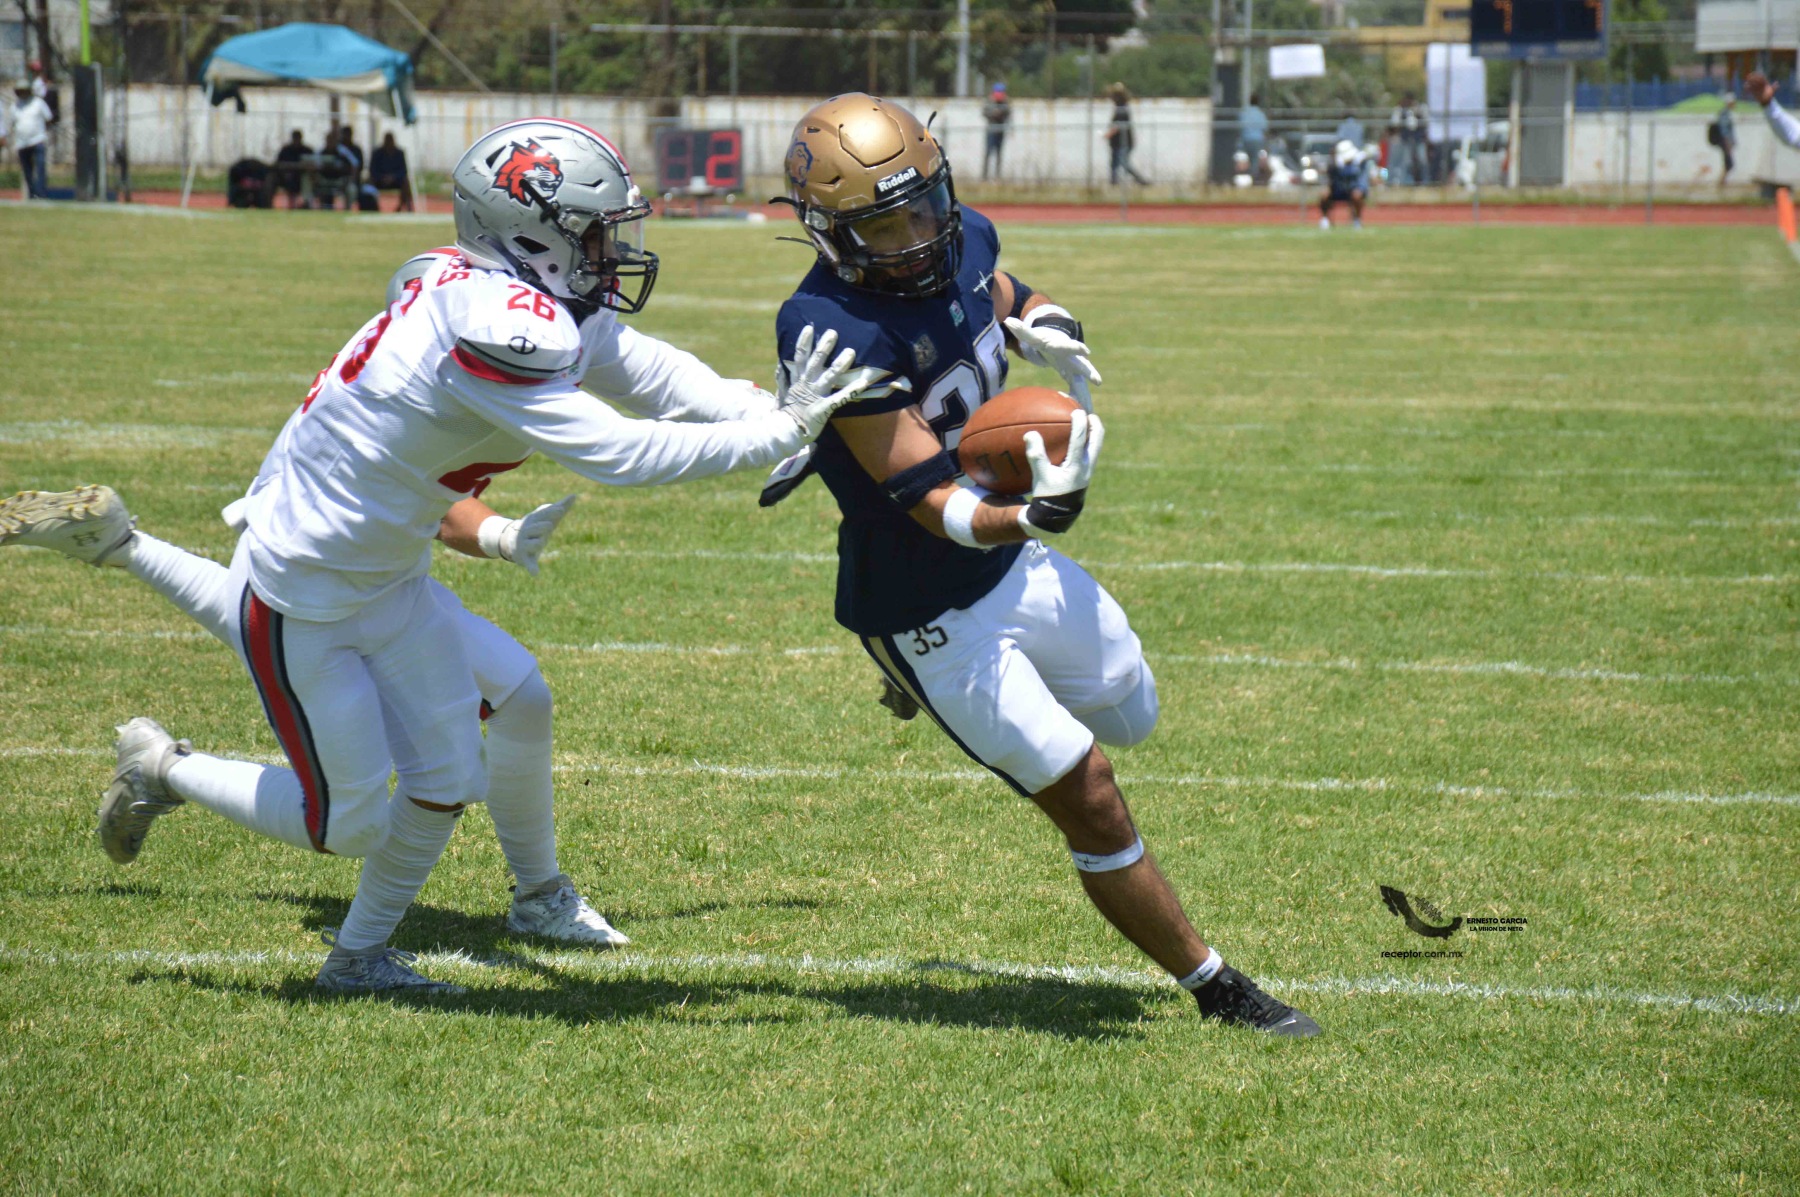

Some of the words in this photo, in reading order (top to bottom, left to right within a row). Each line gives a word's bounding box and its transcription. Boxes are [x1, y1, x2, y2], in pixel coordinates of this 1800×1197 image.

[877, 167, 917, 193] Riddell
[507, 283, 557, 322] 26
[904, 624, 949, 656] 35
